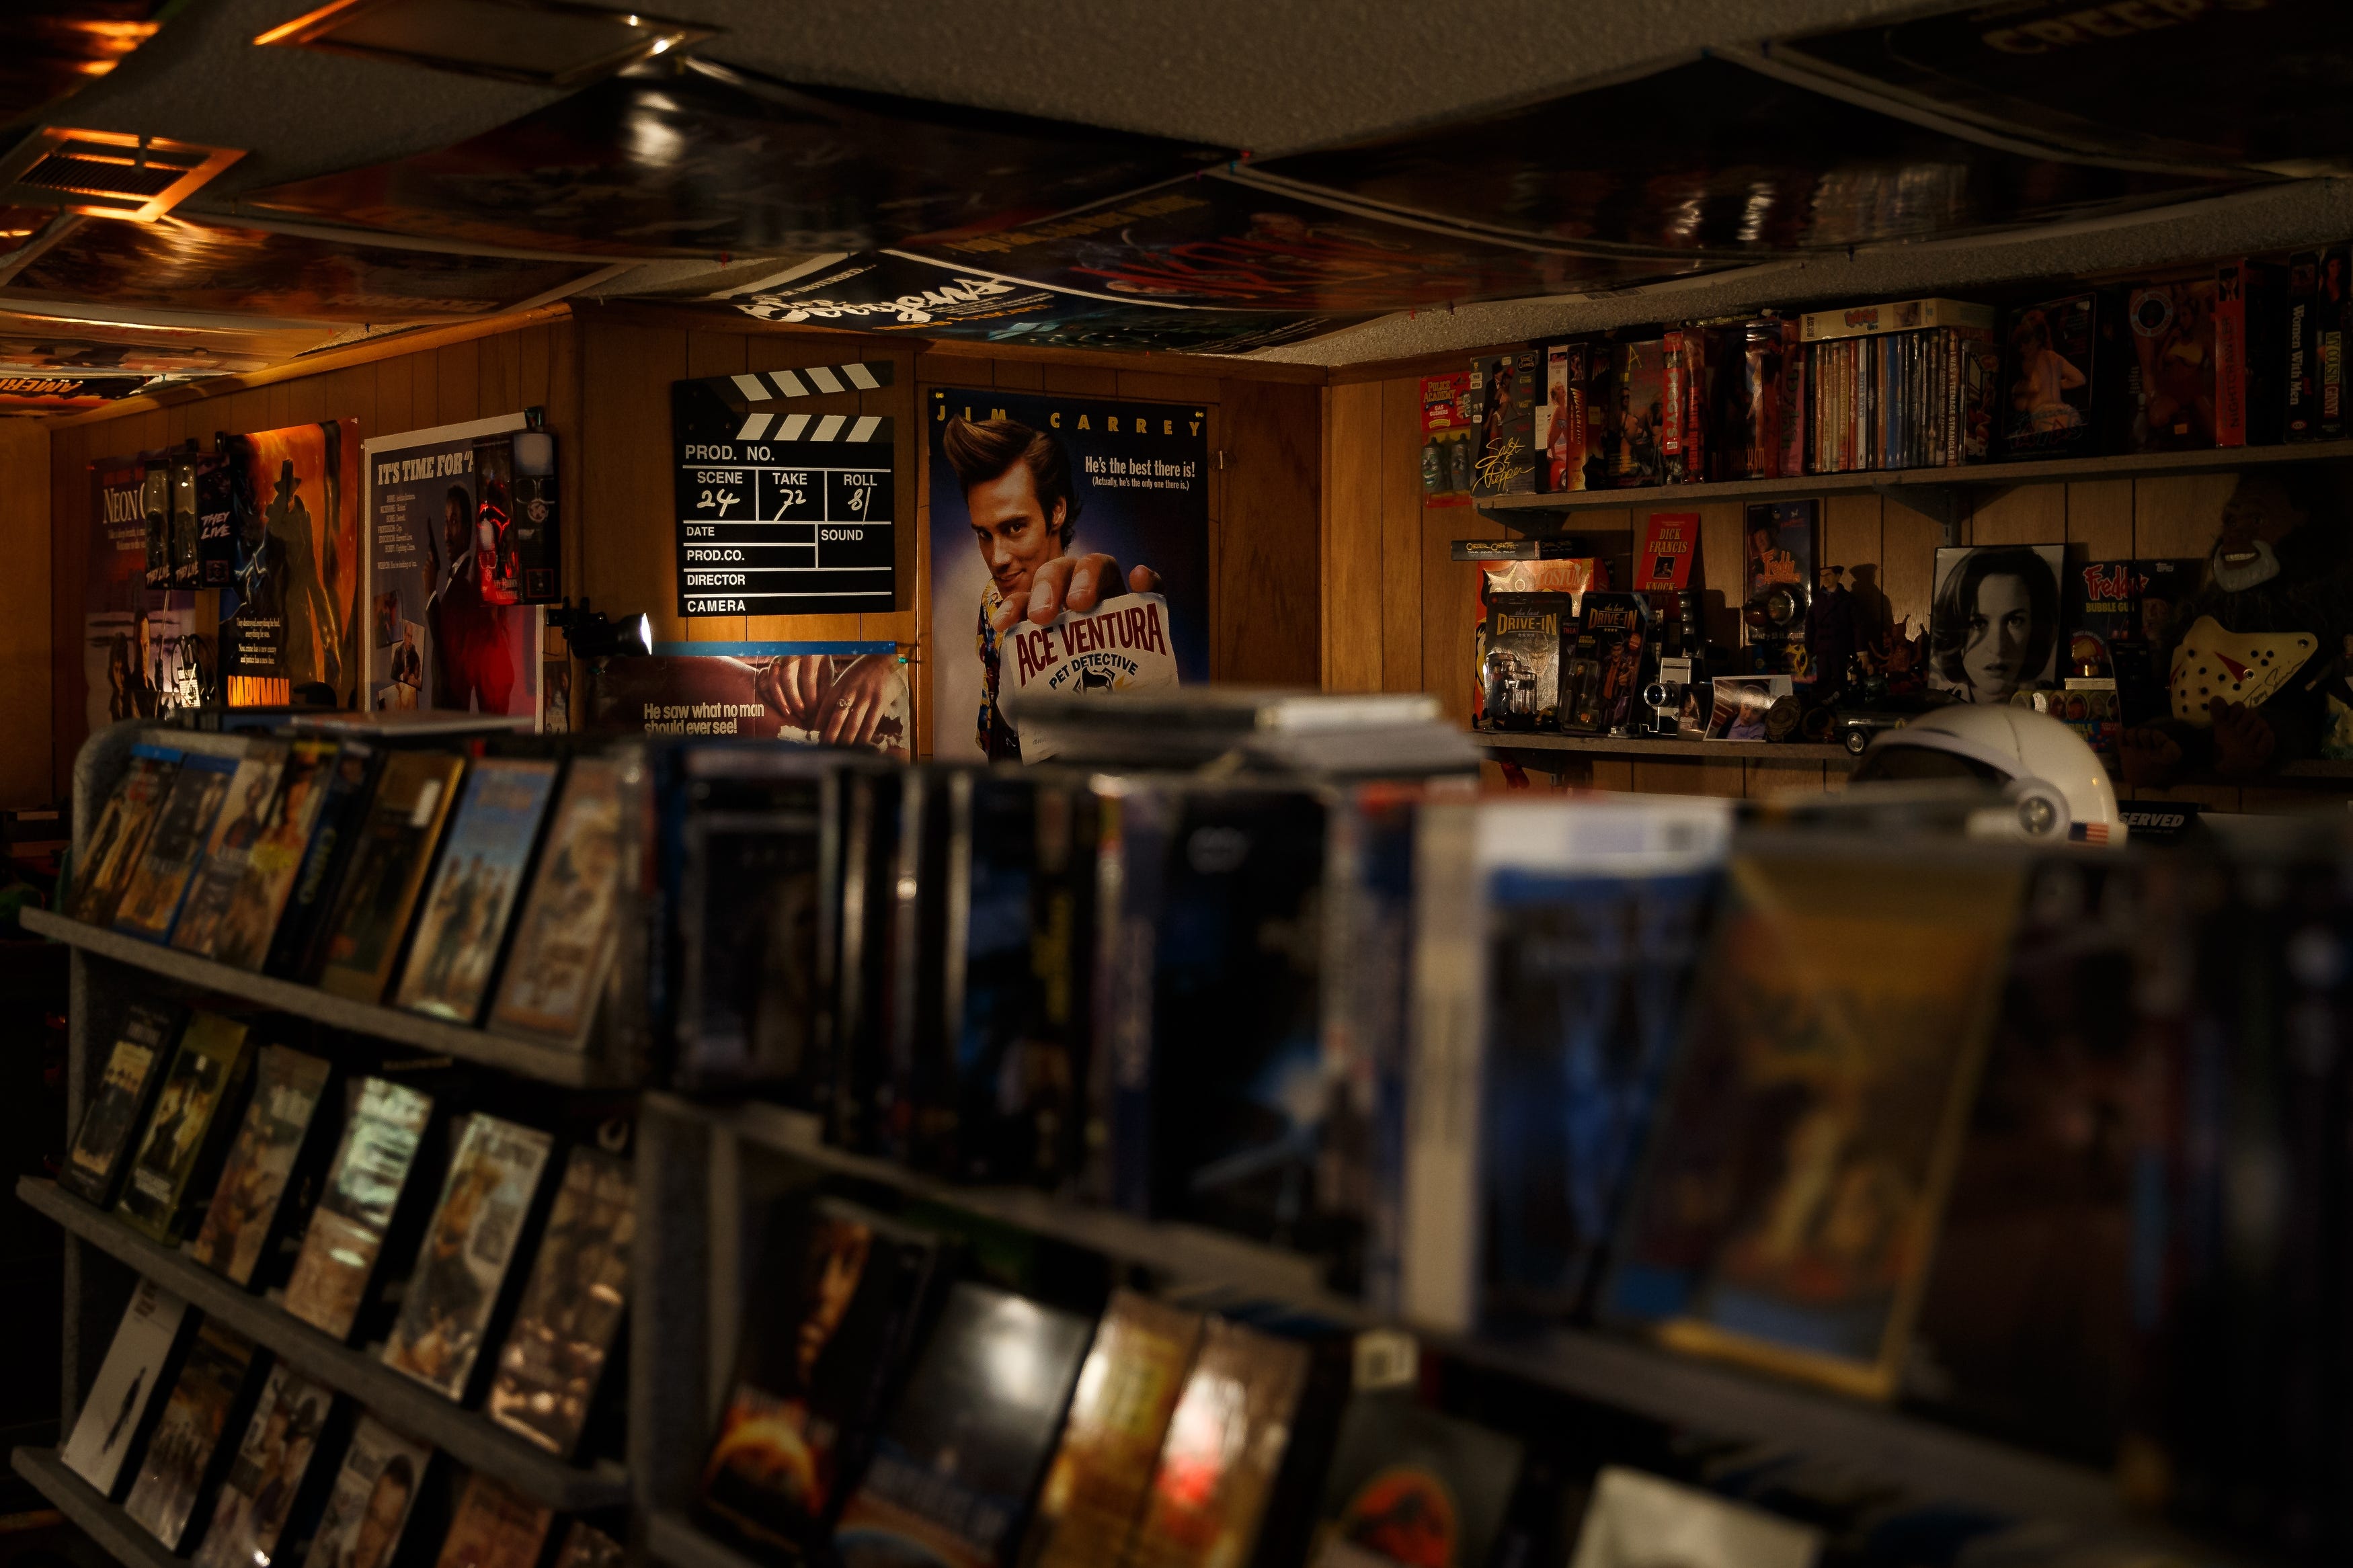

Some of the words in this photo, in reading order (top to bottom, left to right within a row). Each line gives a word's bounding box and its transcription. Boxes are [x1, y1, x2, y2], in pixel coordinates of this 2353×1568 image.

[2292, 303, 2305, 349] Women
[2327, 333, 2341, 347] MY
[2221, 318, 2239, 429] NIGHTCRAWLER
[2291, 349, 2304, 380] With
[2326, 349, 2340, 384] COUSIN
[1427, 380, 1451, 393] POLICE
[2290, 380, 2303, 406] Men
[1423, 389, 1457, 403] ACADEMY
[1948, 381, 1957, 414] TEENAGE
[2324, 385, 2340, 415] GINNY
[937, 405, 1007, 422] JIM
[1049, 412, 1201, 437] CARREY
[1948, 416, 1956, 460] STRANGLER
[685, 444, 737, 461] PROD.
[747, 446, 775, 462] NO.
[1475, 437, 1526, 468] Salt
[378, 462, 401, 486] IT'S
[402, 456, 436, 483] TIME
[437, 452, 463, 478] FOR
[1084, 456, 1107, 473] He's
[1109, 457, 1126, 474] the
[1129, 458, 1152, 476] best
[1154, 460, 1181, 477] there
[1183, 461, 1195, 478] is!
[697, 471, 743, 485] SCENE
[772, 472, 807, 485] TAKE
[844, 474, 877, 486] ROLL
[1092, 476, 1118, 488] (Actually,
[1119, 477, 1130, 487] he's
[1131, 478, 1141, 487] the
[1142, 479, 1153, 489] only
[1154, 481, 1164, 489] one
[1165, 479, 1179, 489] there
[1180, 480, 1189, 491] is.)
[1471, 462, 1536, 496] Pepper
[103, 487, 138, 524] NEON
[696, 489, 740, 518] 24
[774, 489, 807, 522] 72
[200, 511, 231, 526] THEY
[200, 524, 231, 540] LIVE
[686, 526, 715, 536] DATE
[821, 529, 864, 541] SOUND
[1659, 528, 1682, 540] DICK
[686, 550, 746, 561] PROD.CO.
[1648, 541, 1689, 554] FRANCIS
[1761, 548, 1796, 575] Freddy
[687, 574, 746, 586] DIRECTOR
[1645, 582, 1679, 593] KNOCK-
[687, 600, 746, 612] CAMERA
[1515, 608, 1525, 616] the
[1527, 606, 1539, 616] last
[2085, 602, 2116, 612] BUBBLE
[1496, 612, 1558, 636] DRIVE-IN
[1587, 607, 1638, 631] DRIVE-IN
[1015, 626, 1059, 689] ACE
[1059, 602, 1166, 657] VENTURA
[1048, 664, 1071, 690] PET
[1070, 653, 1139, 676] DETECTIVE
[643, 702, 661, 719] He
[663, 705, 689, 719] saw
[691, 702, 721, 718] what
[723, 704, 738, 718] no
[740, 704, 764, 717] man
[643, 719, 684, 734] should
[686, 721, 713, 735] ever
[713, 718, 737, 735] see!
